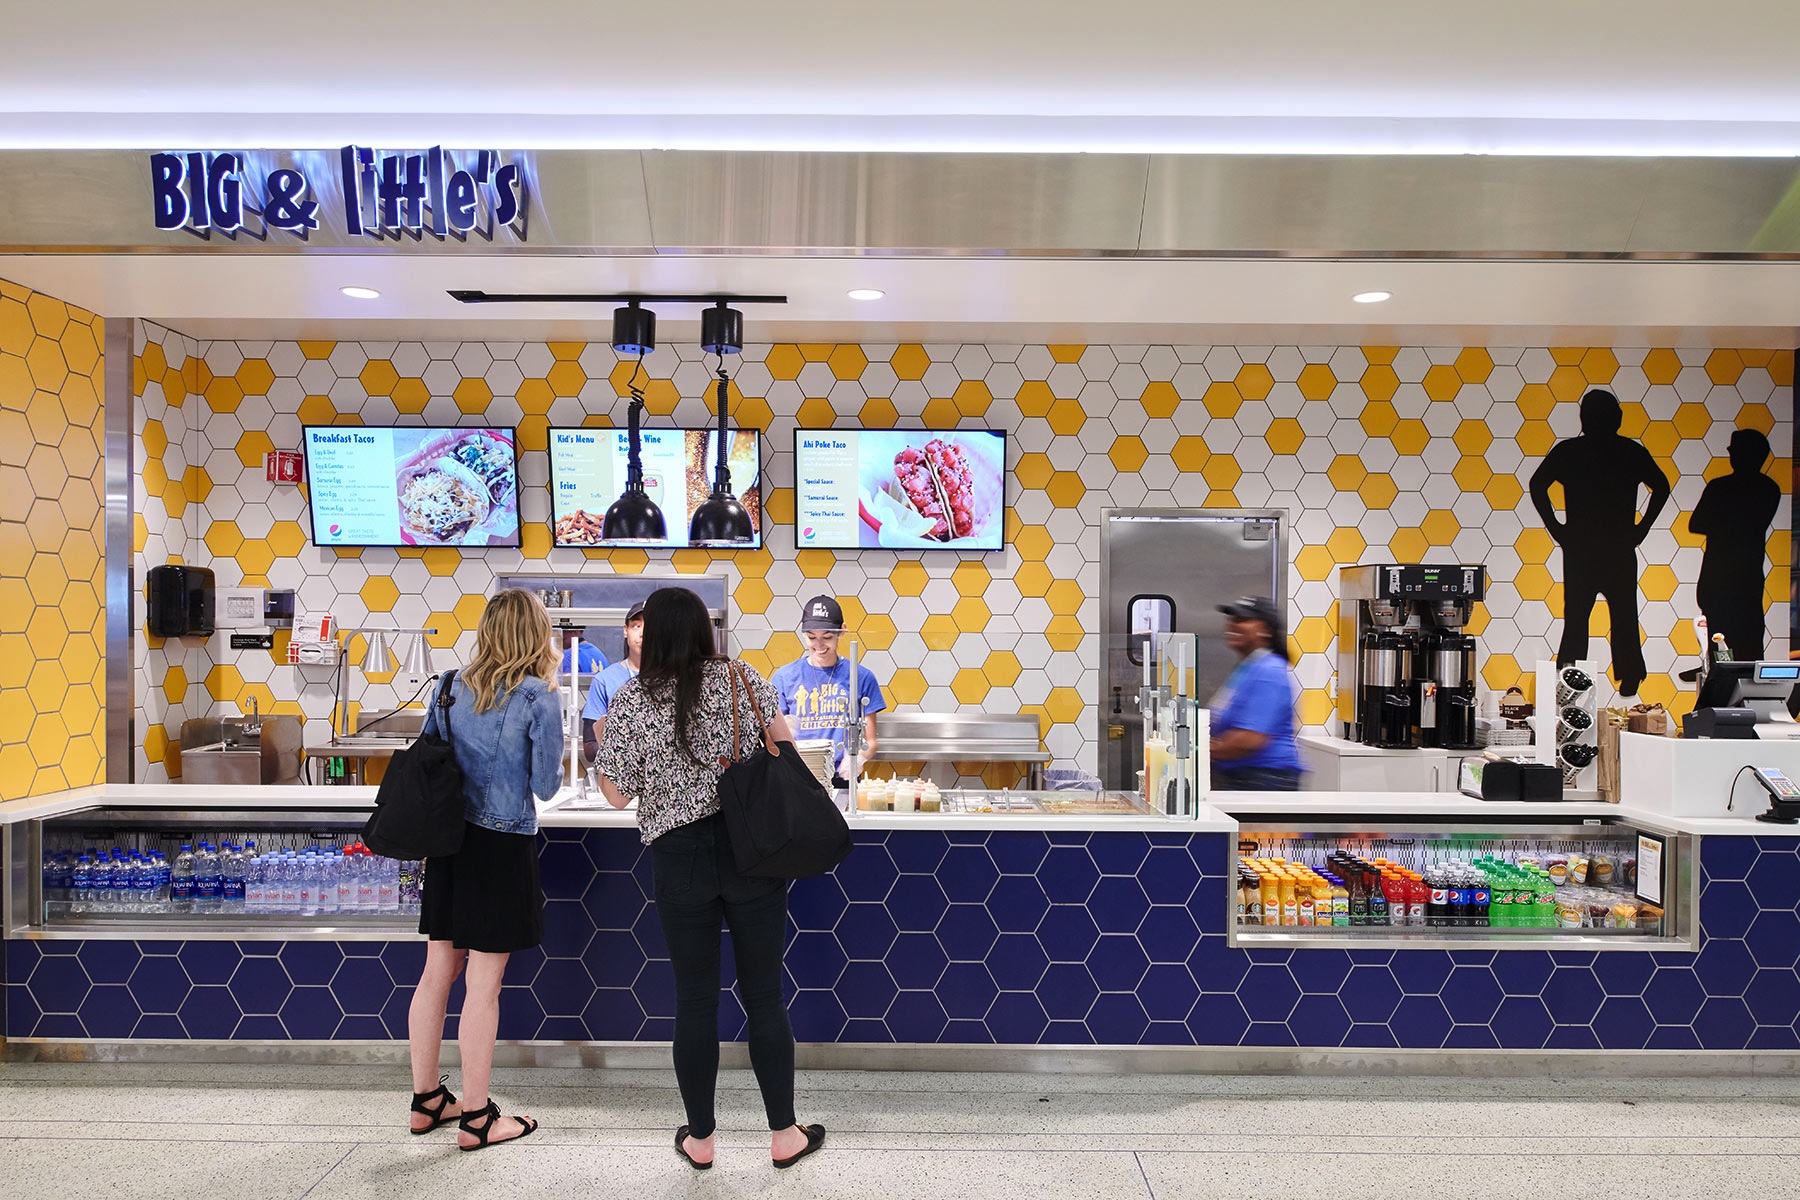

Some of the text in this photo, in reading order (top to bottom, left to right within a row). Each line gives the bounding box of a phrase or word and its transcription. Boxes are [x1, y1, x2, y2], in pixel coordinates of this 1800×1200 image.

[150, 144, 519, 236] BIG & little's
[313, 433, 375, 444] Breakfast Tacos
[557, 434, 595, 443] Kid's Menu
[644, 435, 661, 444] Wine
[803, 440, 814, 448] Ahi
[815, 440, 831, 448] Poke
[559, 481, 577, 490] Fries
[821, 683, 839, 697] BIG
